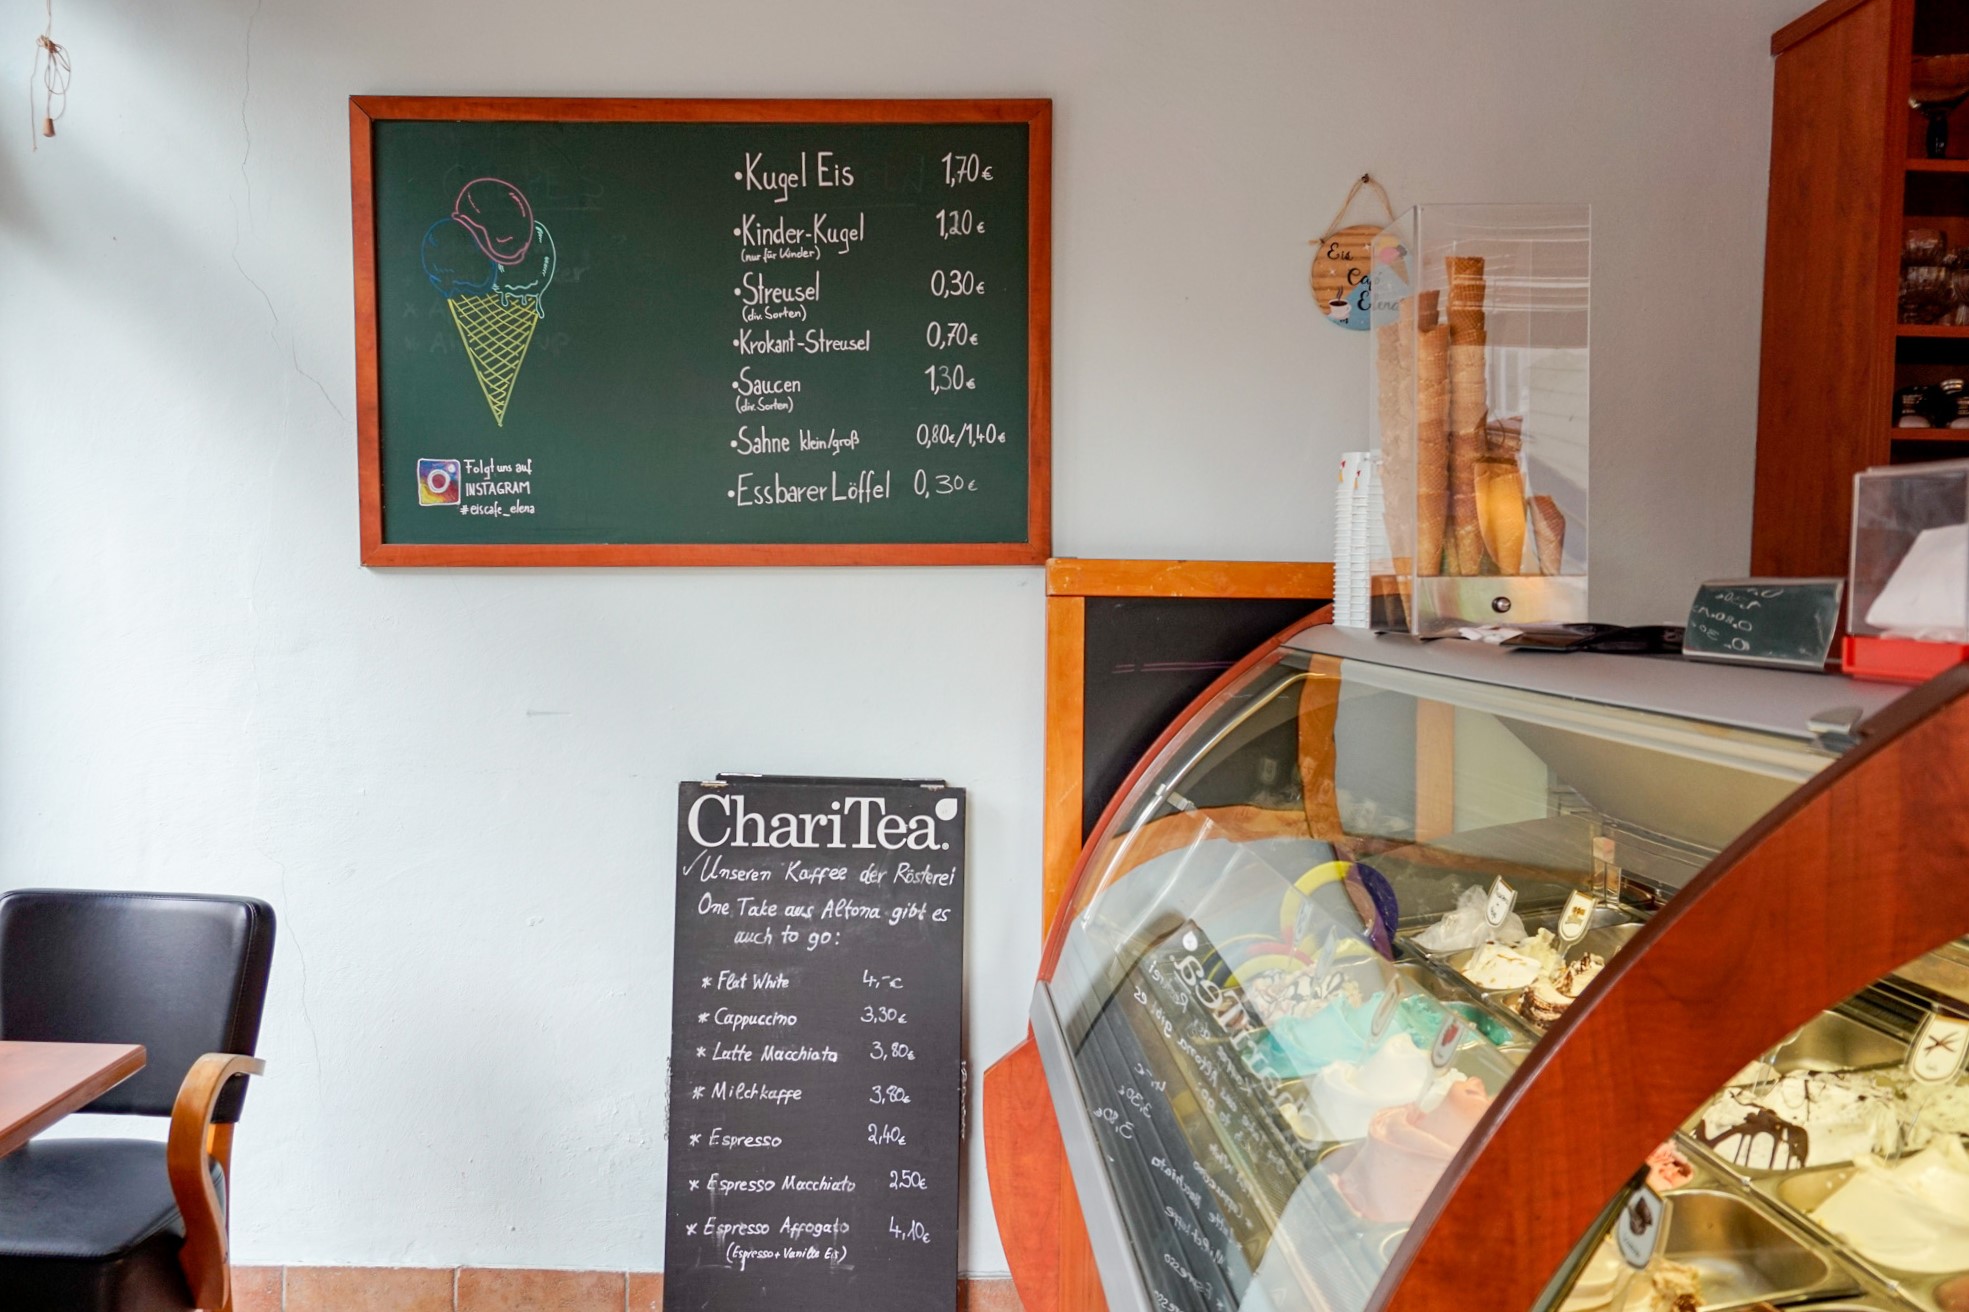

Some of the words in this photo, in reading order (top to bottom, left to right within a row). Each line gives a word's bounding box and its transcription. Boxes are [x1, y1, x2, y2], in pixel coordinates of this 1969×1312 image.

[745, 151, 806, 203] Kugel
[817, 151, 855, 187] Eis
[941, 152, 994, 188] 1,70€
[742, 212, 865, 255] Kinder-Kugel
[741, 248, 761, 262] (nur
[763, 247, 777, 263] für
[1327, 242, 1354, 260] Eis
[742, 270, 820, 305] Streusel
[931, 270, 985, 299] 0,30€
[742, 305, 762, 323] (div.
[764, 304, 807, 321] Sorten)
[739, 328, 871, 355] Krokant-Streusel
[926, 321, 979, 350] 0,70€
[738, 365, 801, 397] Saucen
[924, 364, 976, 395] 1,30€
[737, 425, 790, 456] Sahne
[800, 428, 860, 456] klein/groß
[463, 457, 494, 480] Folgt
[497, 463, 513, 473] uns
[515, 457, 533, 475] auf
[465, 481, 531, 497] INSTAGRAM
[737, 472, 828, 507] Essbarer
[832, 469, 891, 504] Löffel
[459, 498, 535, 517] #eiscafe_elena
[700, 854, 772, 883] Unseren
[785, 860, 847, 886] Kaffee
[859, 862, 888, 887] der
[893, 861, 957, 887] Rösterei
[697, 892, 730, 916] One
[737, 896, 777, 918] Take
[784, 903, 813, 920] aus
[821, 898, 881, 920] Altona
[888, 903, 927, 926] gibt
[932, 906, 951, 923] es
[734, 926, 773, 946] auch
[781, 925, 799, 945] to
[806, 930, 840, 951] go:
[717, 970, 747, 990] Flat
[753, 972, 790, 991] White
[714, 1006, 798, 1031] Cappuccino
[860, 1005, 908, 1024] 3,30€
[711, 1040, 752, 1062] Latte
[869, 1040, 916, 1062] 3,80€
[869, 1084, 912, 1105] 3,80€
[709, 1127, 783, 1150] Espresso
[867, 1122, 907, 1145] 2,40€
[706, 1172, 776, 1196] Espresso
[781, 1175, 856, 1193] Macchiato
[703, 1216, 770, 1238] Espresso
[779, 1216, 850, 1240] Affogato
[888, 1215, 932, 1244] 4,10€
